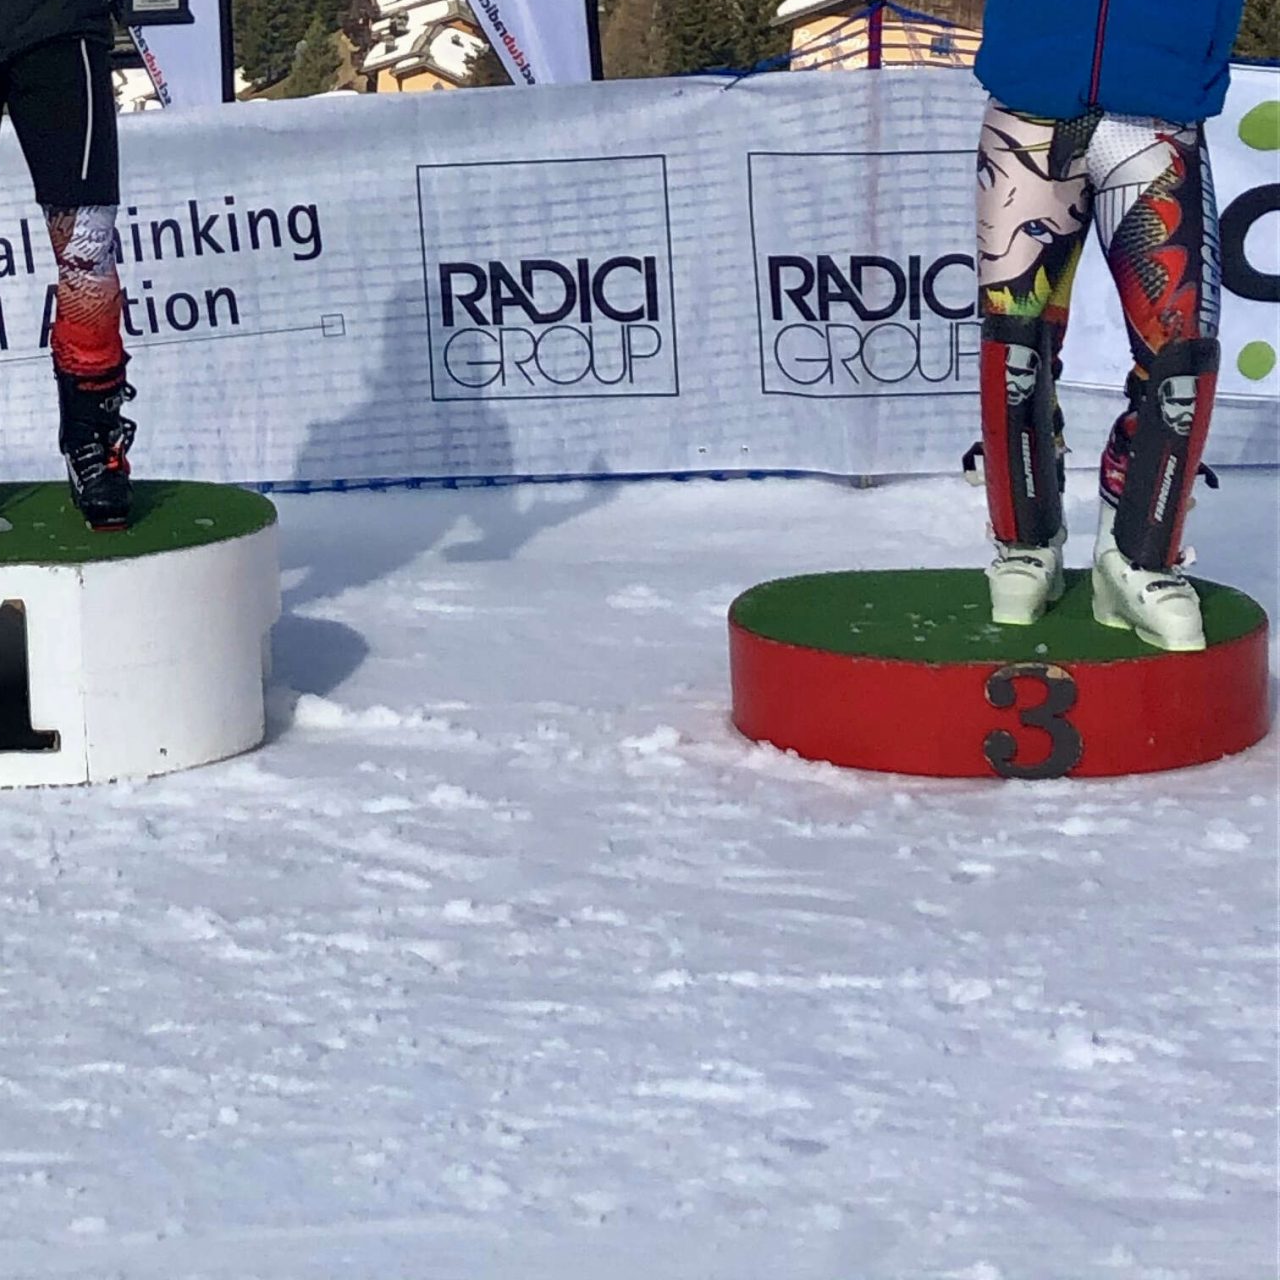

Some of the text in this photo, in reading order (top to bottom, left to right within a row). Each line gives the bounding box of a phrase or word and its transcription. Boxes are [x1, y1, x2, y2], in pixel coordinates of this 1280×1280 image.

[439, 255, 660, 327] RADICI
[768, 253, 985, 322] RADIC
[443, 324, 662, 389] GROUP
[983, 661, 1084, 780] 3
